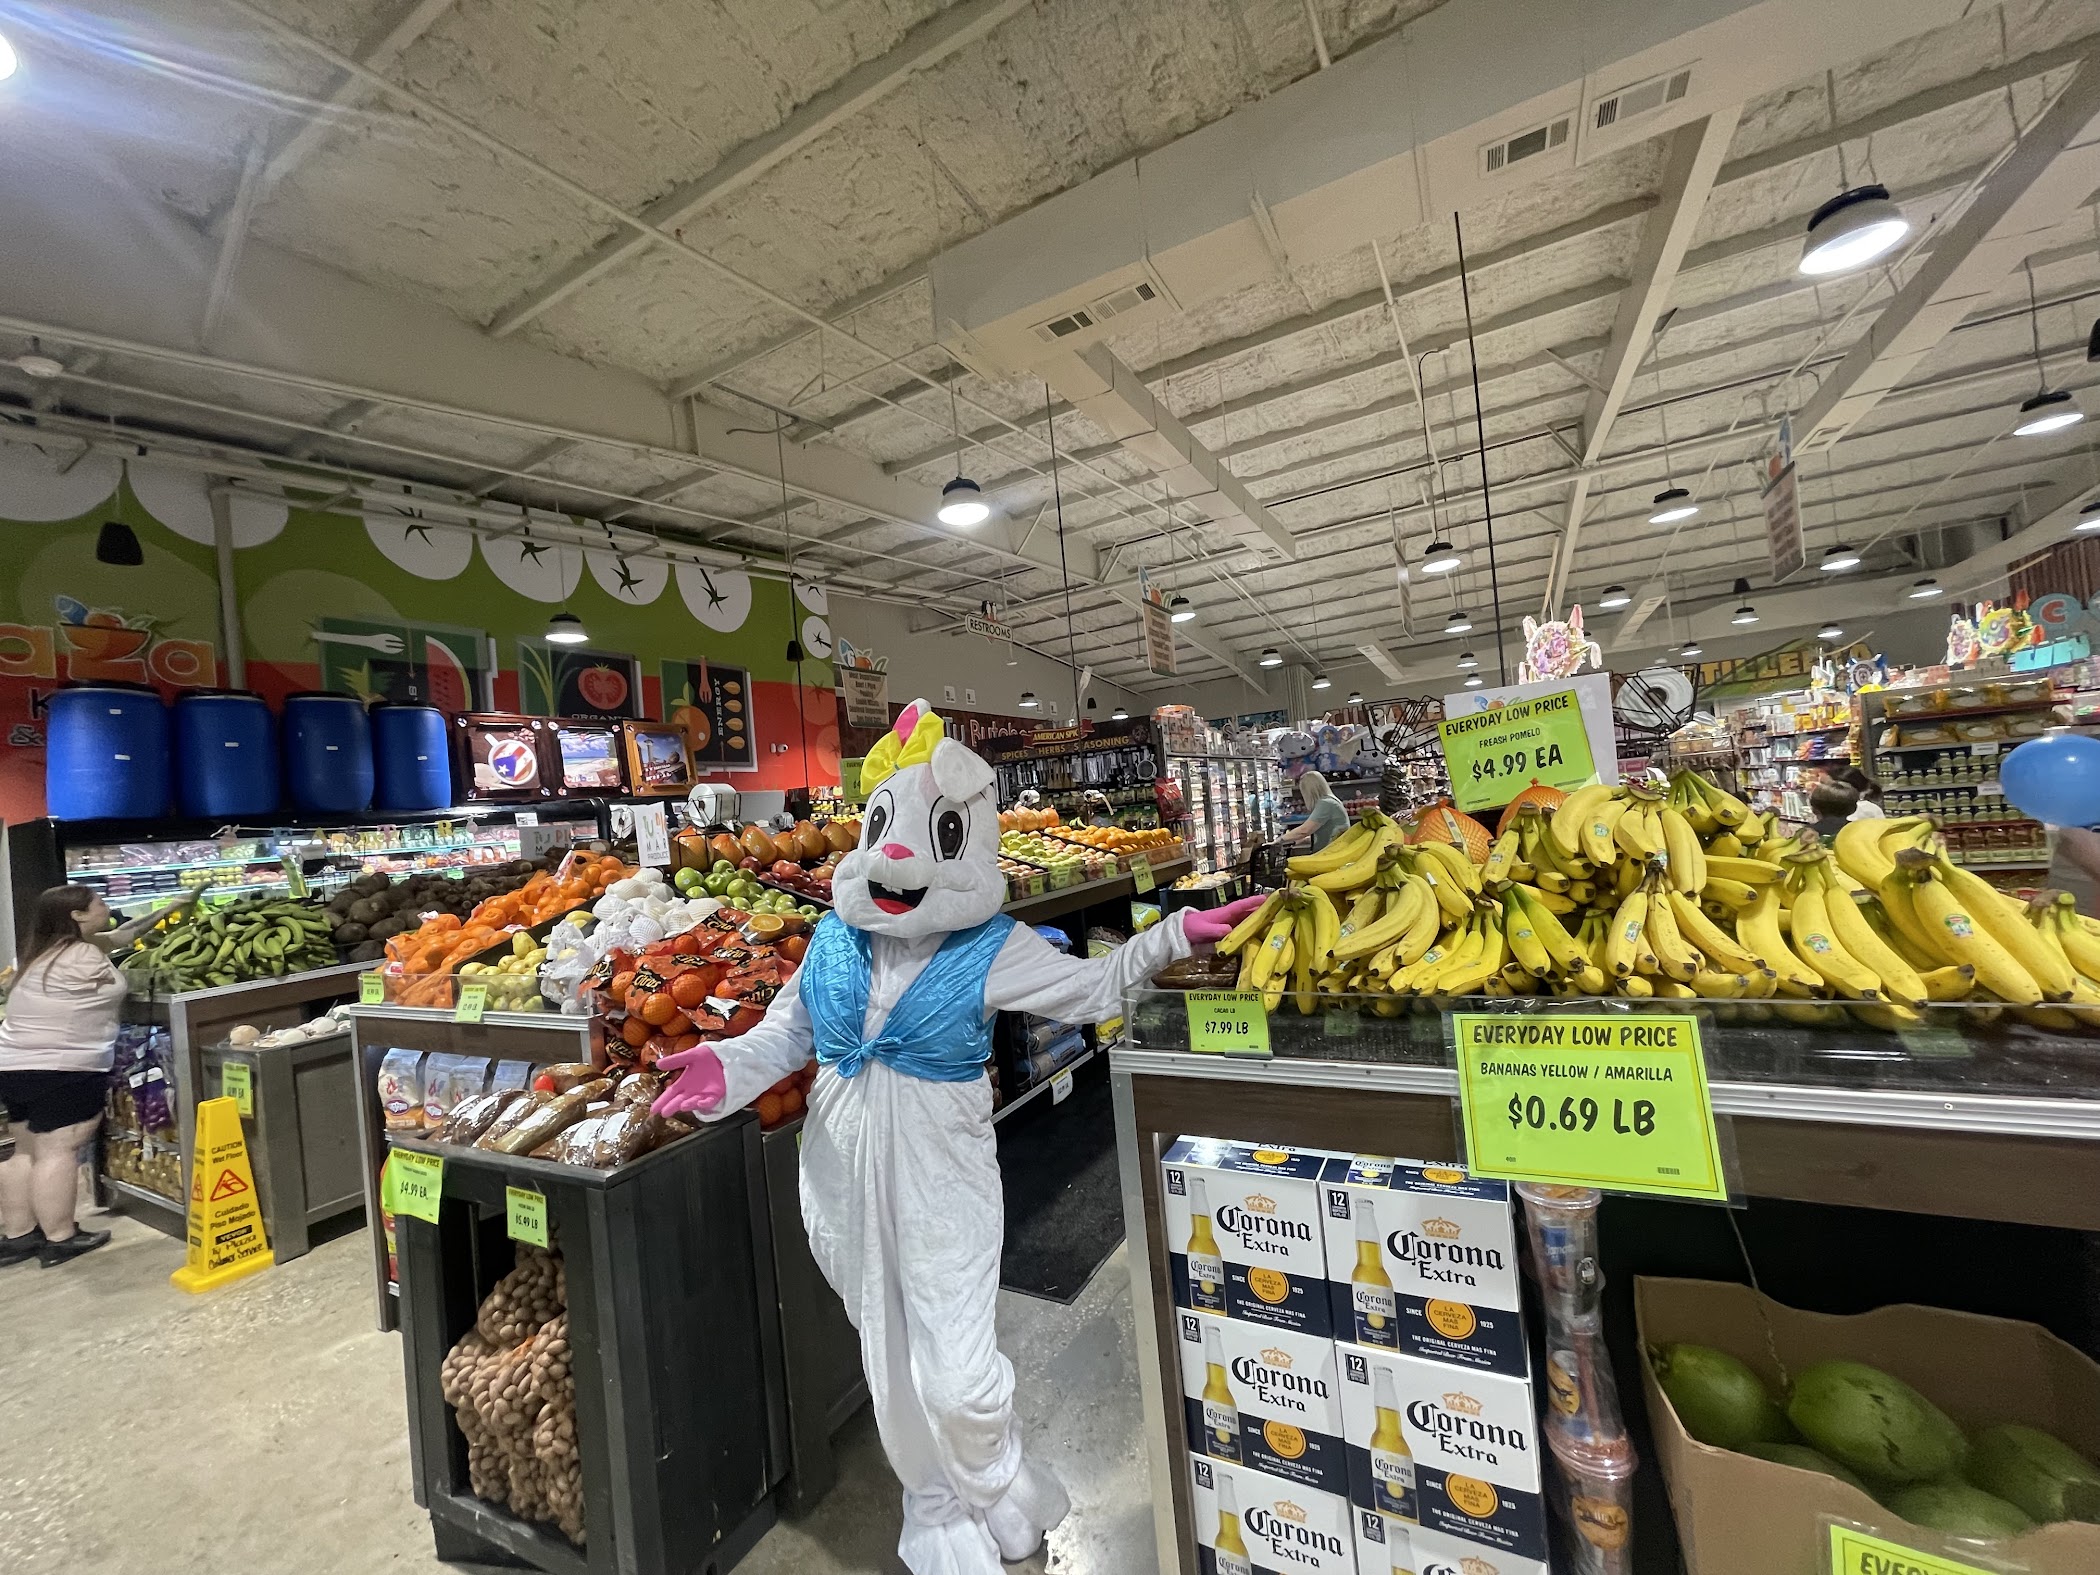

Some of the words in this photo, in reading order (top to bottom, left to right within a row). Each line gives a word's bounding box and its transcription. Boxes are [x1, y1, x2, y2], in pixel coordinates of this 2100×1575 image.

[970, 618, 1011, 638] RESTROOMS
[714, 678, 724, 736] ENERGY
[1446, 712, 1502, 736] EVERYDAY
[1506, 706, 1530, 722] LOW
[1535, 695, 1569, 715] PRICE
[943, 716, 965, 744] Tu
[1033, 730, 1064, 741] AMERICAN
[1479, 736, 1508, 748] FREASH
[1510, 728, 1541, 742] POMELO
[1002, 750, 1028, 761] SPICES
[1039, 744, 1066, 756] HERBS
[1073, 736, 1129, 751] SASONING
[1472, 752, 1527, 782] $4.99
[1536, 744, 1564, 768] EA
[647, 852, 669, 860] PRODUCE
[634, 974, 662, 988] Citrus
[1205, 1021, 1232, 1034] $7.99
[1236, 1022, 1248, 1034] LB
[1474, 1024, 1565, 1046] EVERYDAY
[1572, 1026, 1612, 1046] LOW
[1620, 1026, 1678, 1047] PRICE
[1480, 1062, 1537, 1077] BANANAS
[1541, 1064, 1588, 1078] YELLOW
[1594, 1066, 1600, 1079] /
[1604, 1066, 1673, 1082] AMARILLA
[1508, 1092, 1598, 1132] $0.69
[1613, 1098, 1656, 1136] LB
[211, 1140, 243, 1154] CAUTION
[212, 1155, 225, 1164] Wet
[226, 1150, 243, 1161] Floor
[393, 1152, 414, 1162] EVERYDAY
[415, 1155, 426, 1164] LOW
[426, 1158, 440, 1167] PRICE
[1355, 1160, 1391, 1168] Corona
[1170, 1172, 1181, 1184] 12
[400, 1180, 418, 1197] $4.99
[1332, 1192, 1345, 1206] 12
[214, 1202, 250, 1218] Cuidado
[210, 1220, 227, 1230] Piso
[228, 1210, 256, 1226] Mojado
[531, 1219, 539, 1230] LB
[1216, 1204, 1313, 1242] Corona
[237, 1244, 264, 1259] Service
[1242, 1232, 1289, 1256] Extra
[1387, 1229, 1505, 1270] Corona
[1190, 1260, 1222, 1274] Corona
[1418, 1261, 1476, 1287] Extra
[1198, 1271, 1216, 1280] Extra
[1232, 1274, 1245, 1283] SINCE
[1254, 1278, 1281, 1286] CERVEZA
[1356, 1290, 1392, 1307] Corona
[1364, 1302, 1386, 1314] Extra
[1434, 1311, 1467, 1320] CERVEZA
[1185, 1317, 1197, 1331] 12
[1406, 1308, 1422, 1316] SINCE
[1480, 1320, 1494, 1329] 1925
[1443, 1323, 1459, 1331] FINA
[1350, 1357, 1363, 1372] 12
[1232, 1356, 1330, 1400] Corona
[1258, 1385, 1306, 1412] Extra
[1206, 1407, 1236, 1425] Corona
[1213, 1419, 1231, 1430] Extra
[1406, 1400, 1527, 1451] Corona
[1438, 1434, 1498, 1465] Extra
[1198, 1463, 1209, 1476] 12
[1374, 1458, 1412, 1478] Corona
[1383, 1471, 1405, 1484] Extra
[1426, 1479, 1442, 1490] SINCE
[1454, 1486, 1488, 1498] CERVEZA
[1464, 1494, 1480, 1502] MAS
[1366, 1514, 1379, 1529] 12
[1245, 1507, 1344, 1556] Corona
[1271, 1538, 1320, 1568] Extra
[1219, 1556, 1249, 1574] Corona
